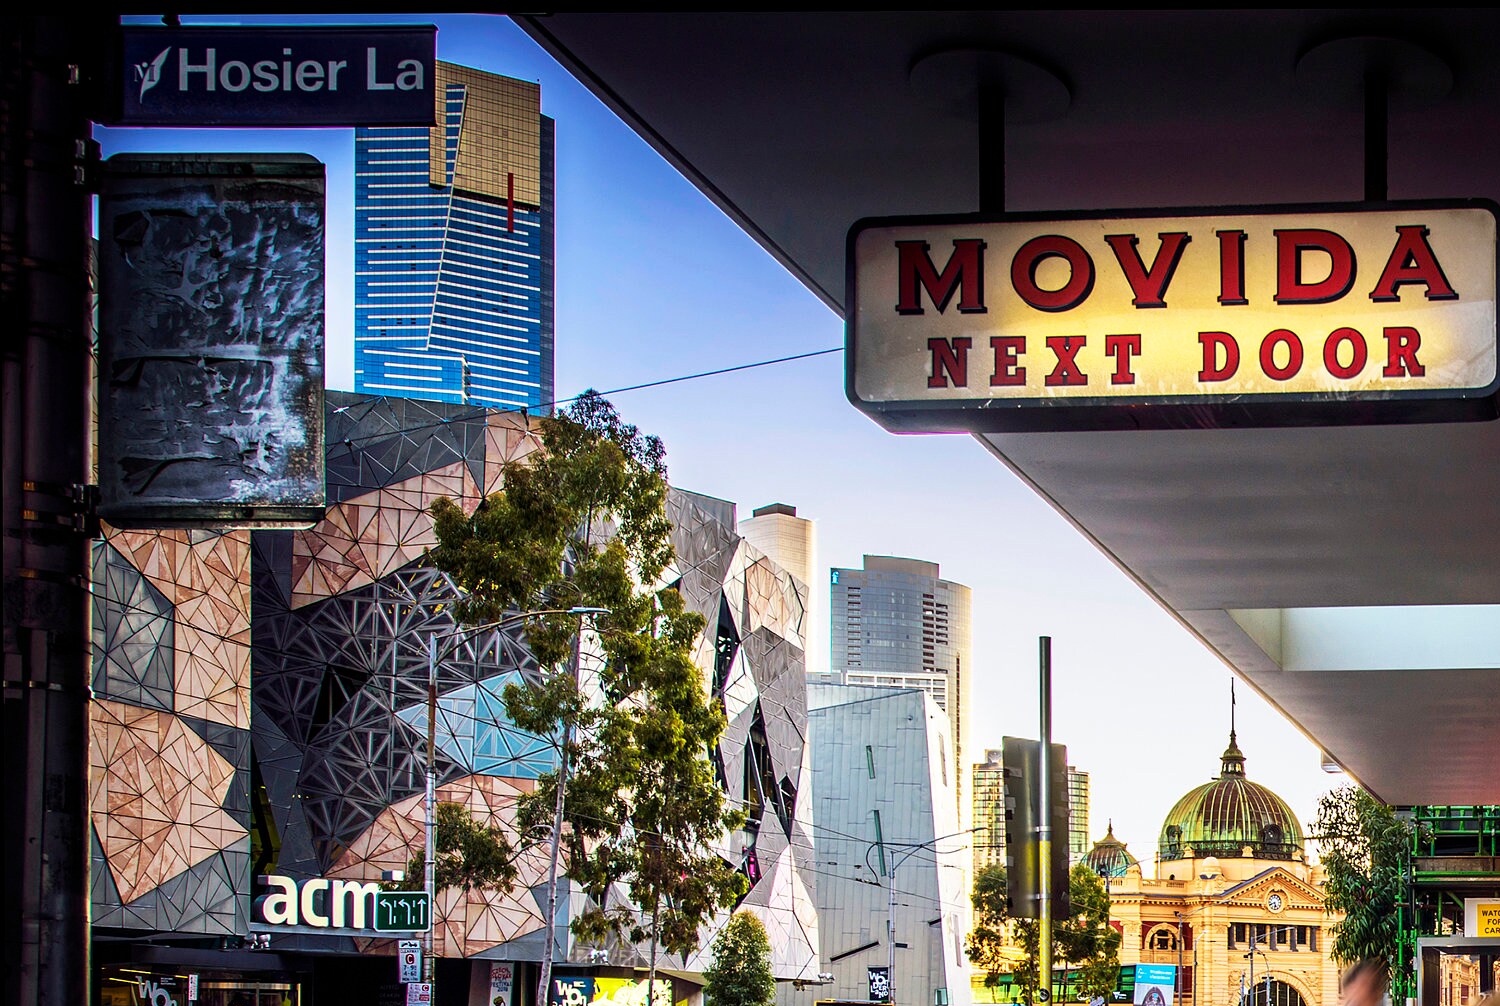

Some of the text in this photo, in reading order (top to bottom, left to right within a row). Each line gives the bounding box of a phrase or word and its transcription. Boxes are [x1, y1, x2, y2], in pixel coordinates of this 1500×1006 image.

[178, 47, 347, 92] Hosier
[366, 48, 425, 91] La
[894, 225, 1459, 315] MOVIDA
[927, 326, 1426, 388] NEXT DOOR
